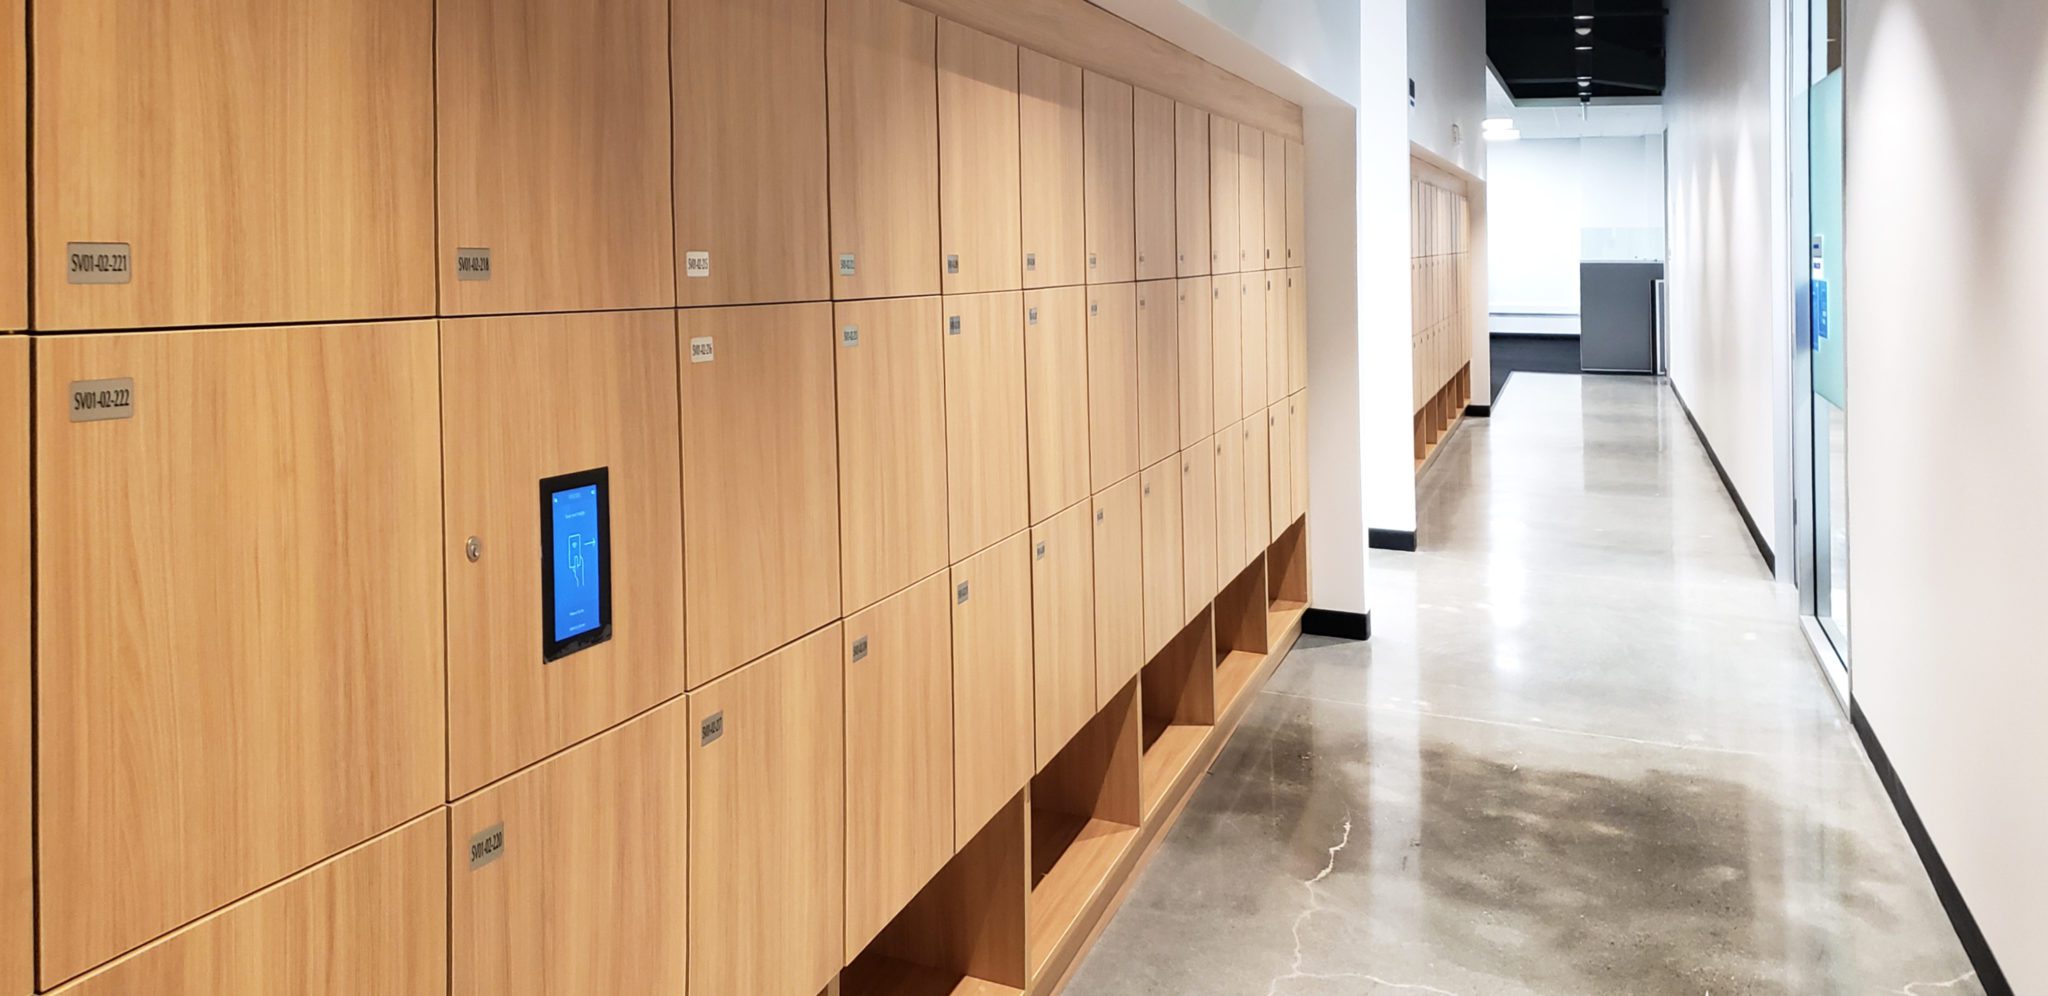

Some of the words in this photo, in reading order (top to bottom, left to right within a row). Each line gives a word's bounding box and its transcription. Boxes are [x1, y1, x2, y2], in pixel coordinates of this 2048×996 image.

[71, 253, 127, 272] SV01-02-221
[458, 257, 489, 271] SV01-02-218
[74, 389, 130, 411] SV01-02-222
[471, 831, 502, 861] SV01-02-220
